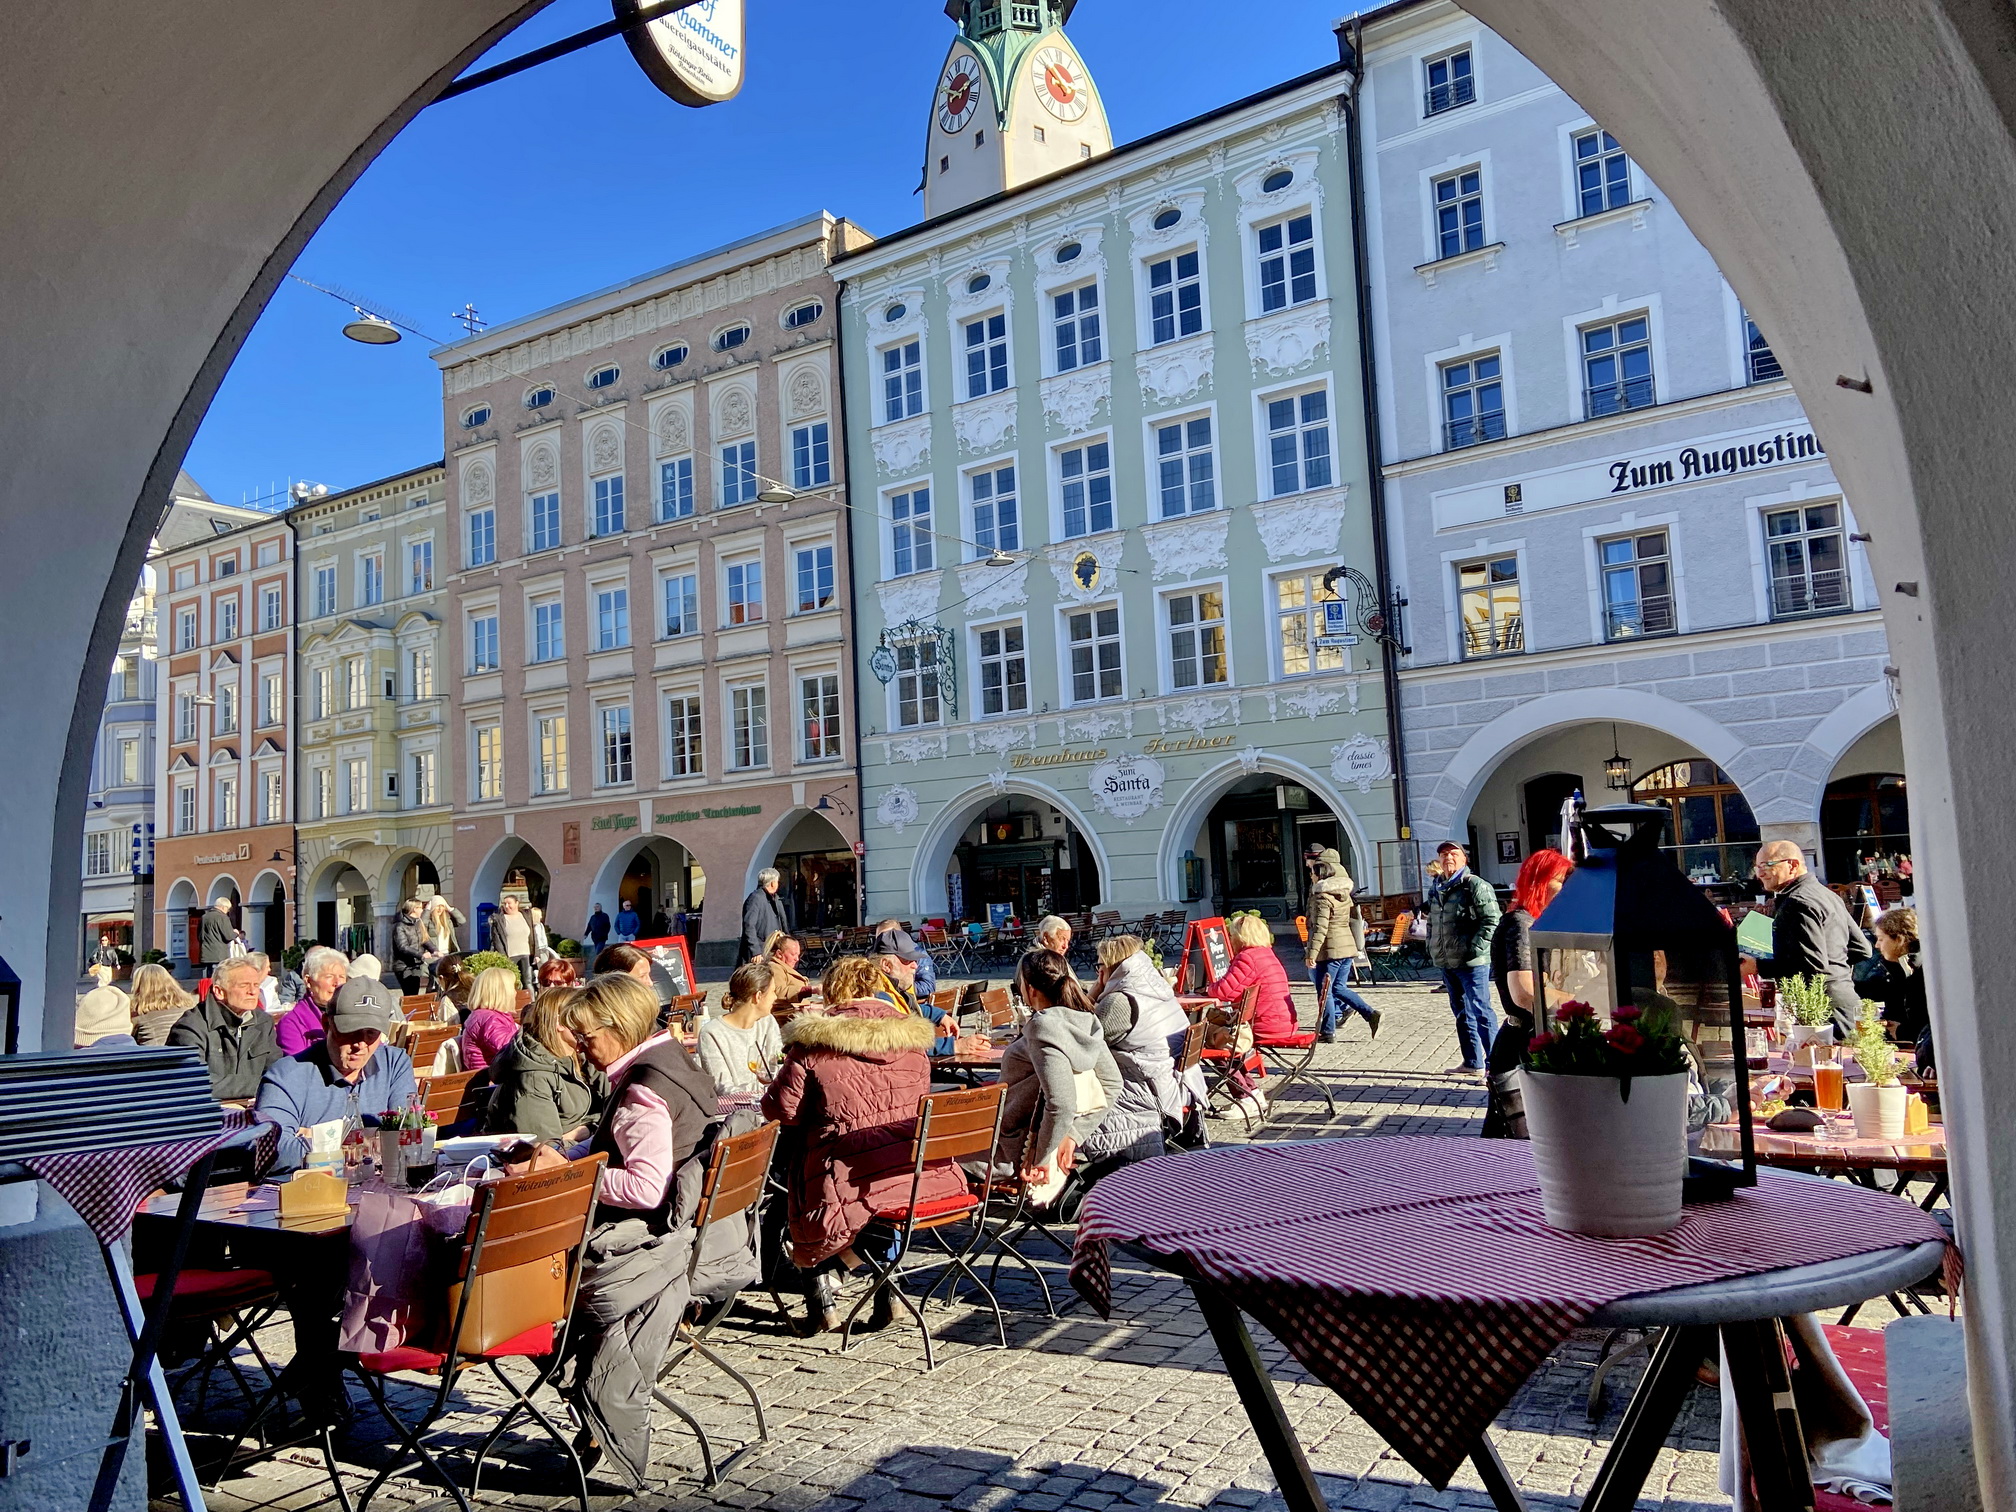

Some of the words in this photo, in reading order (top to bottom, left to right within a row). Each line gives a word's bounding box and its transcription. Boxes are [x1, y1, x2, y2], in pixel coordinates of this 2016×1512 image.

[674, 8, 738, 60] hammer
[659, 17, 732, 76] auereigaststätte
[1609, 460, 1675, 493] Zum
[1010, 748, 1108, 768] Weinhaus
[1347, 750, 1376, 761] classic
[1351, 761, 1372, 770] times
[1103, 774, 1150, 795] Santa
[194, 854, 221, 865] Deutsche
[221, 851, 237, 862] Bank
[304, 1178, 320, 1193] 64
[512, 1176, 562, 1195] Flötzinger
[561, 1168, 585, 1183] Bräu
